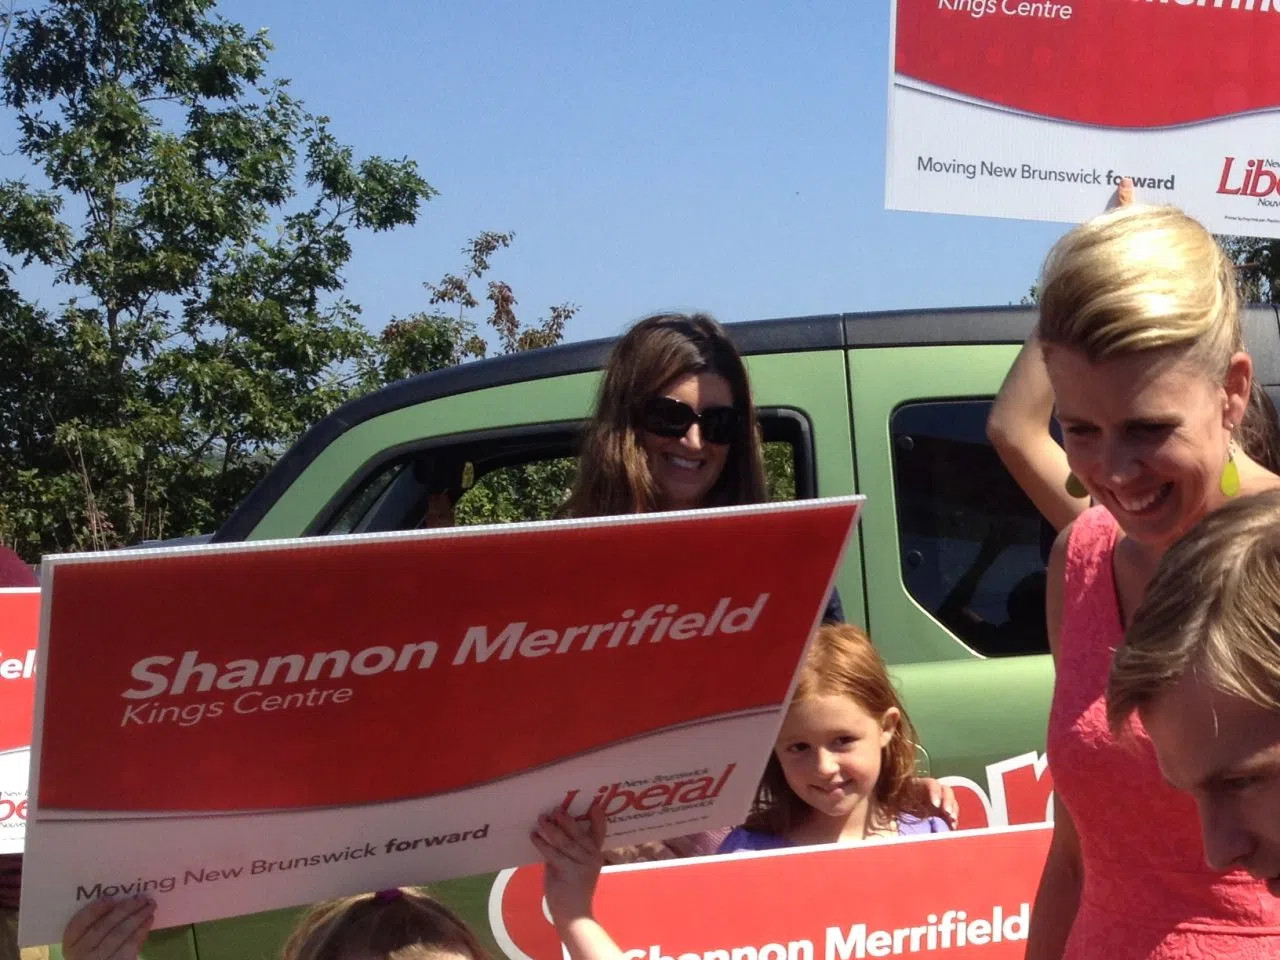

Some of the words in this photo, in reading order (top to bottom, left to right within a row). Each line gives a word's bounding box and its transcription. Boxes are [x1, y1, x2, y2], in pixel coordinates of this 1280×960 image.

[1001, 0, 1073, 19] Centre
[917, 156, 977, 180] Moving
[980, 160, 1018, 179] New
[1021, 164, 1102, 186] Brunswick
[1106, 169, 1176, 191] foward
[122, 640, 439, 700] Shannon
[452, 592, 772, 667] Merrifield
[120, 699, 224, 728] Kings
[233, 685, 353, 715] Centre
[550, 763, 737, 822] Liberal
[76, 874, 176, 901] Moving
[184, 866, 244, 885] New
[250, 842, 377, 875] Brunswick
[384, 824, 489, 854] forward
